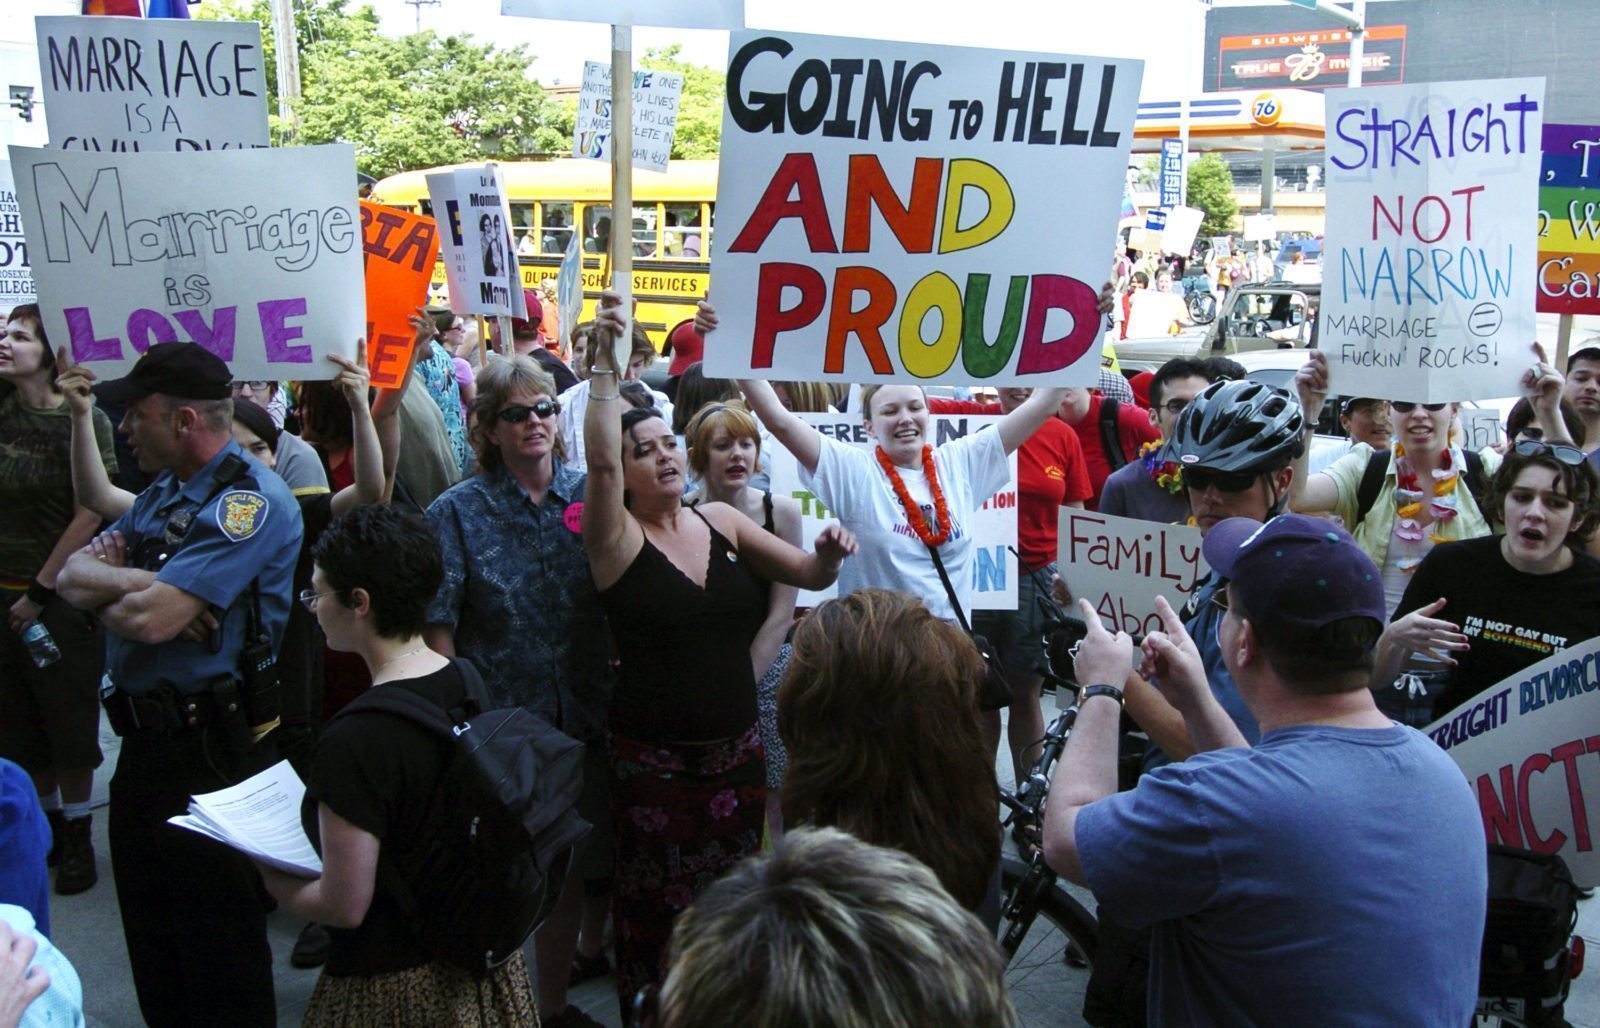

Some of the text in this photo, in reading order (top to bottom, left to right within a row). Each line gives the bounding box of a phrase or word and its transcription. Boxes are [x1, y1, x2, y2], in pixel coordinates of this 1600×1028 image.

[48, 35, 258, 98] MARRIAGE
[1230, 62, 1281, 76] TRUE
[582, 81, 612, 97] ANOTHE
[647, 94, 675, 110] LIVES
[659, 76, 680, 90] ONE
[726, 36, 943, 142] GOING
[993, 61, 1121, 148] HELL
[125, 103, 183, 134] IS A
[1255, 101, 1277, 117] 76
[32, 162, 355, 273] Marriage
[727, 151, 1016, 255] AND
[1372, 185, 1485, 244] NOT
[164, 274, 212, 307] is
[633, 276, 698, 292] SERVICES
[1341, 243, 1513, 307] NARROW
[63, 297, 314, 365] LOVE
[750, 261, 1101, 379] PROUD
[1326, 314, 1438, 339] MARRIAGE
[1418, 341, 1500, 368] ROCKS!
[1462, 625, 1481, 637] MY
[1483, 629, 1552, 653] BOYFRIEND
[1465, 615, 1568, 646] I'M NOT GAY BUT
